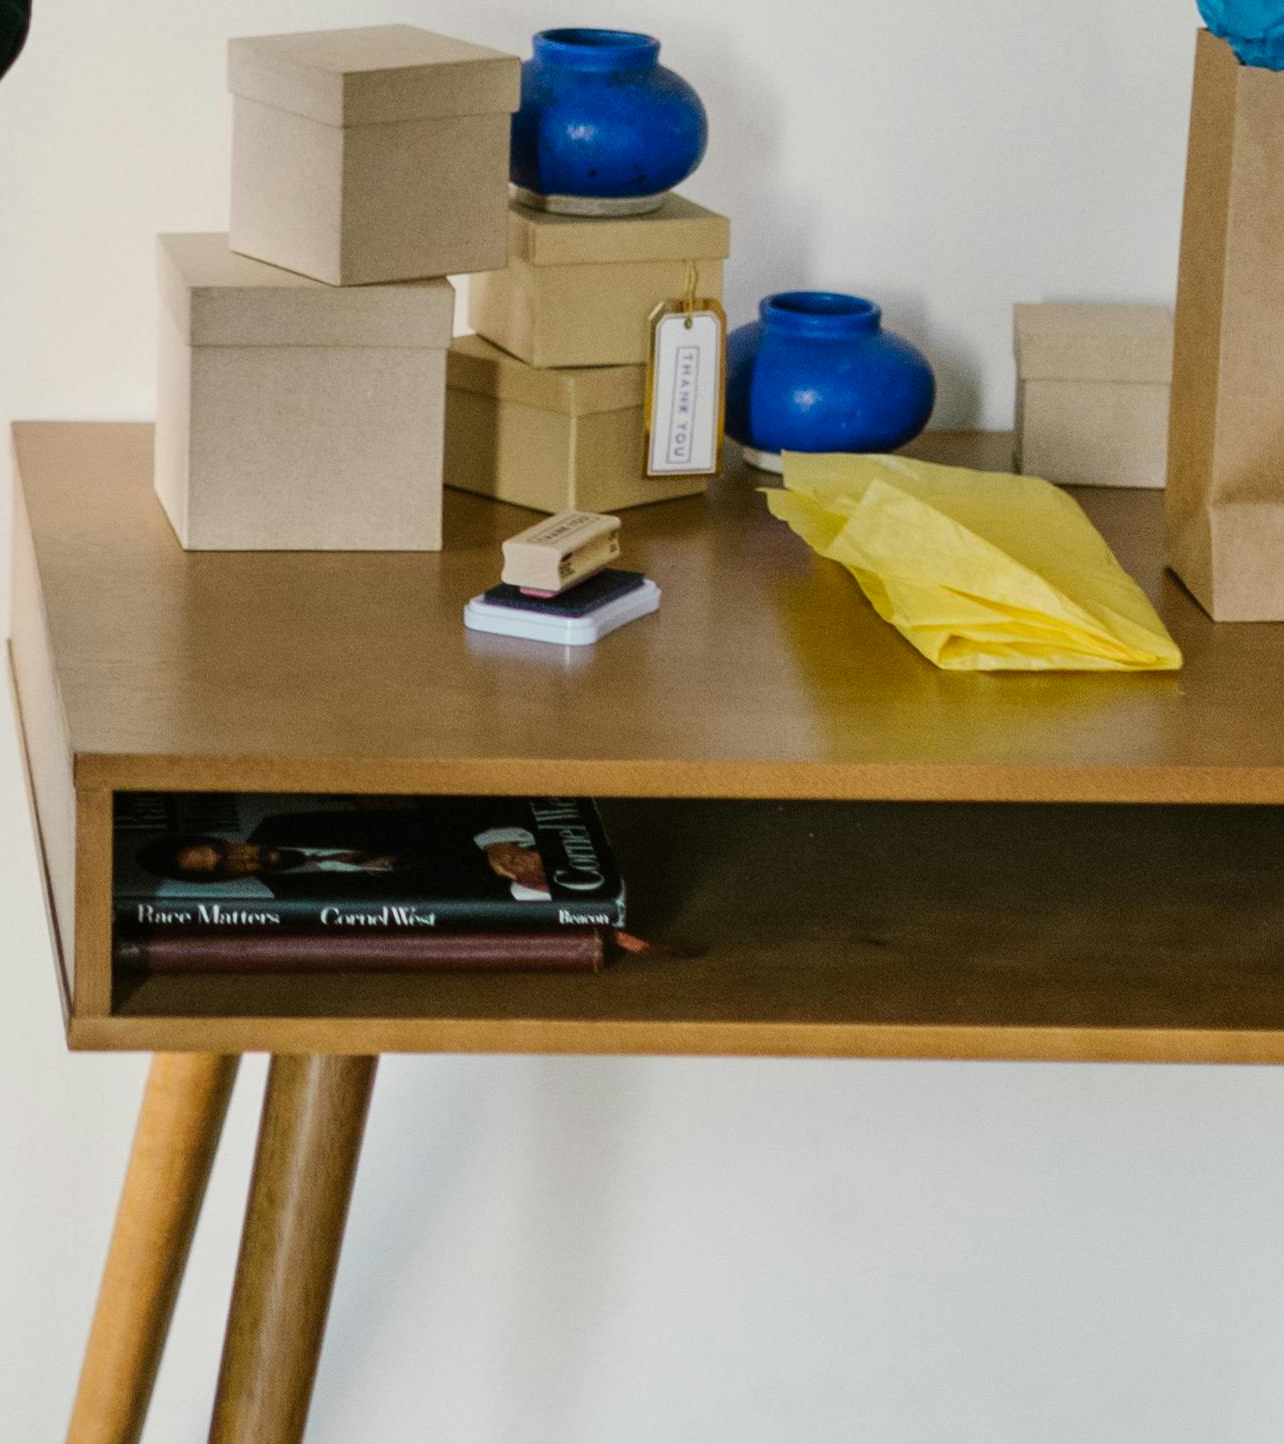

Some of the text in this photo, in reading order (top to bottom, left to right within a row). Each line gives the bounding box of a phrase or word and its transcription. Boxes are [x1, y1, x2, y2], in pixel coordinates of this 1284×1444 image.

[673, 353, 693, 457] THANK YOU
[137, 904, 435, 928] Race Matters Cornel West
[559, 910, 609, 925] Beacon
